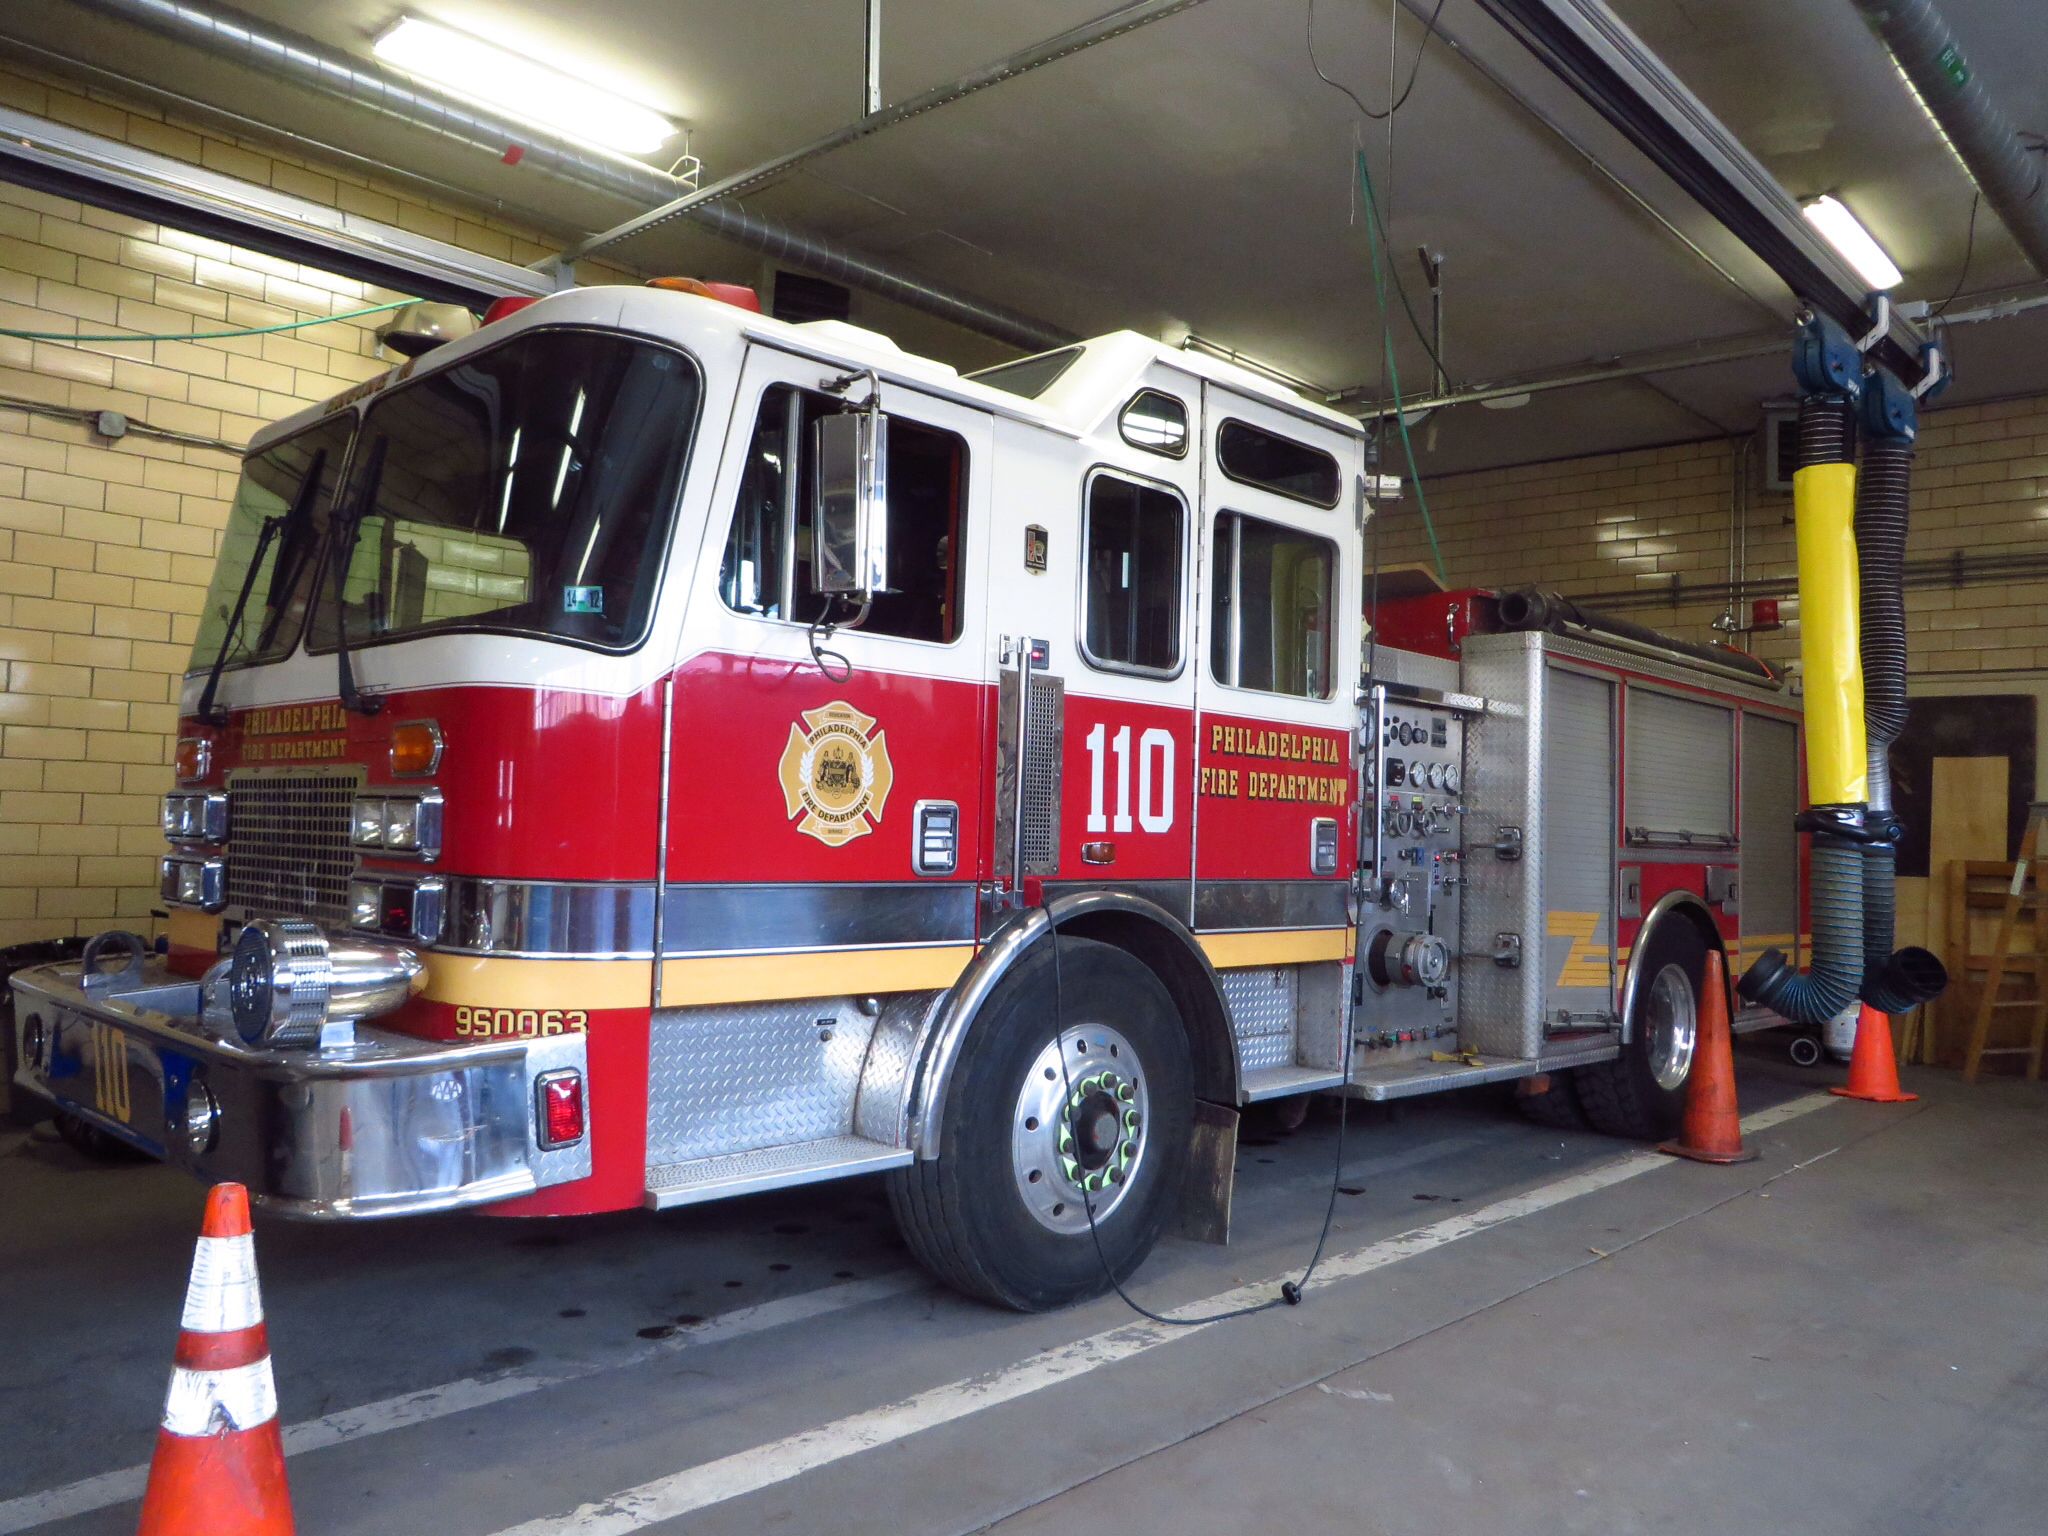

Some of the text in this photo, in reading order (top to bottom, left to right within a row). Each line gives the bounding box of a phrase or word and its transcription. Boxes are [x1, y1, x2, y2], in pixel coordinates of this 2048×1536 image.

[588, 589, 600, 607] 12
[243, 704, 347, 736] PHILADELPHIA
[809, 723, 867, 749] PHILADELPHIA
[242, 739, 347, 760] FIRE DEPARTMENT
[1211, 725, 1339, 765] PHILADELPHIA
[1086, 723, 1175, 833] 110
[1200, 767, 1347, 806] FIRE DEPARTMENT
[801, 791, 871, 823] FIRE DEPARTMENT
[91, 1020, 131, 1124] 110
